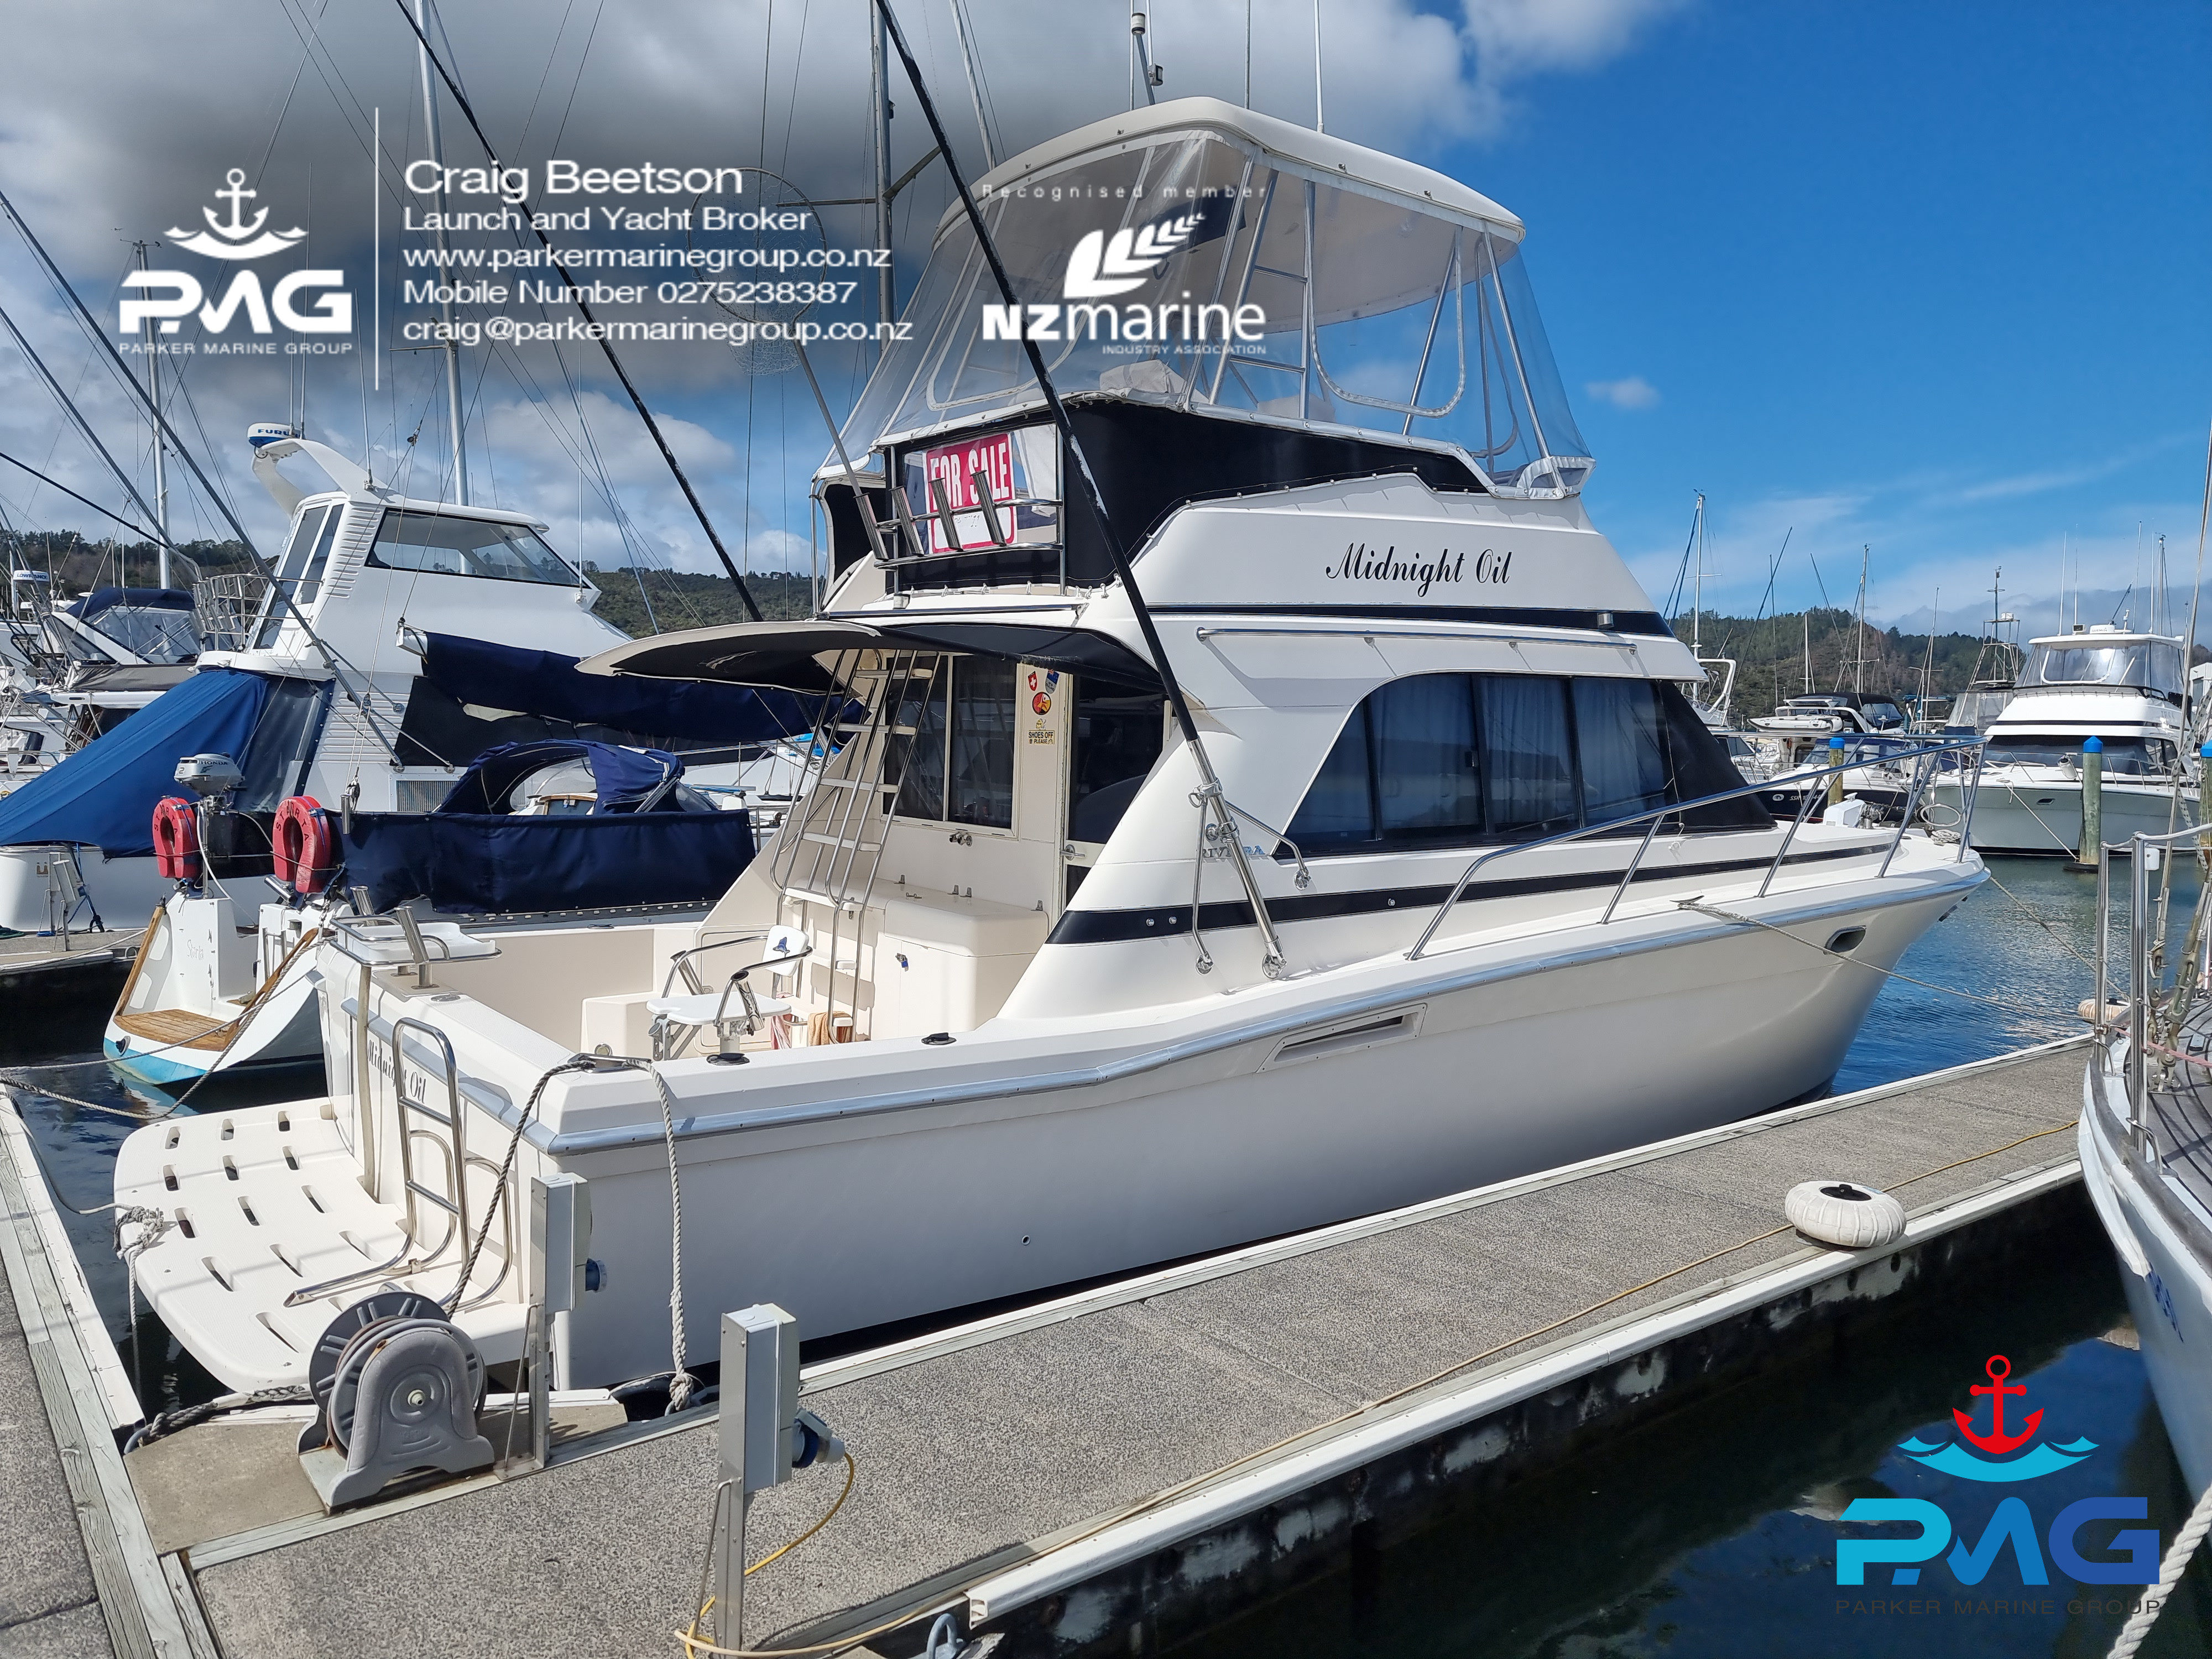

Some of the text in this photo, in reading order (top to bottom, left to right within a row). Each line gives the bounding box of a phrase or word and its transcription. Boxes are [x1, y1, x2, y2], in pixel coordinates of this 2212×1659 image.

[258, 429, 300, 439] FURU
[930, 442, 1010, 510] FOR SALE
[1326, 542, 1512, 597] Midnight Oil
[1196, 845, 1265, 858] RIVIRA
[410, 1071, 426, 1104] Oil
